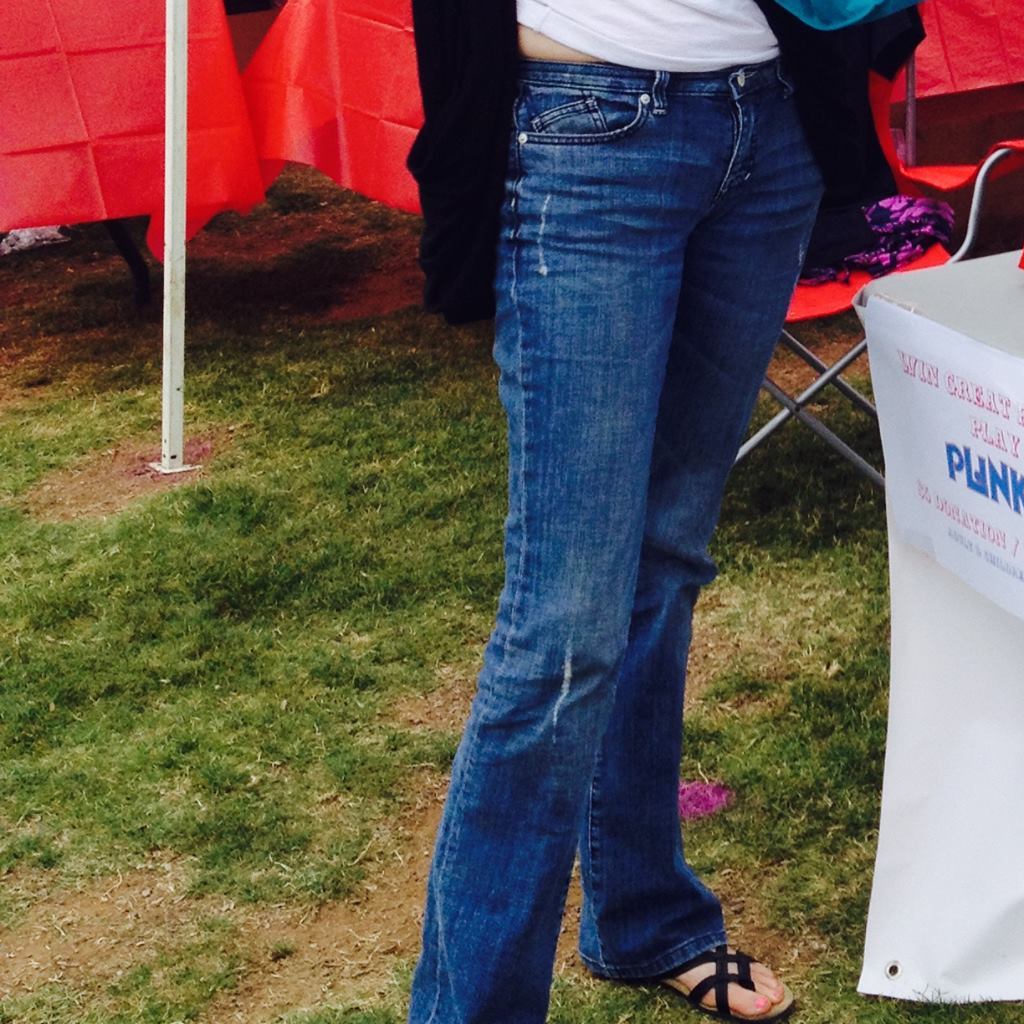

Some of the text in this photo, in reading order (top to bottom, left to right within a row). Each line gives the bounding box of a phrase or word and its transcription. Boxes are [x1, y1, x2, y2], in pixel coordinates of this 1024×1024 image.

[899, 349, 940, 389] WIN
[945, 373, 1011, 419] GREAT
[969, 416, 1021, 459] PLAY
